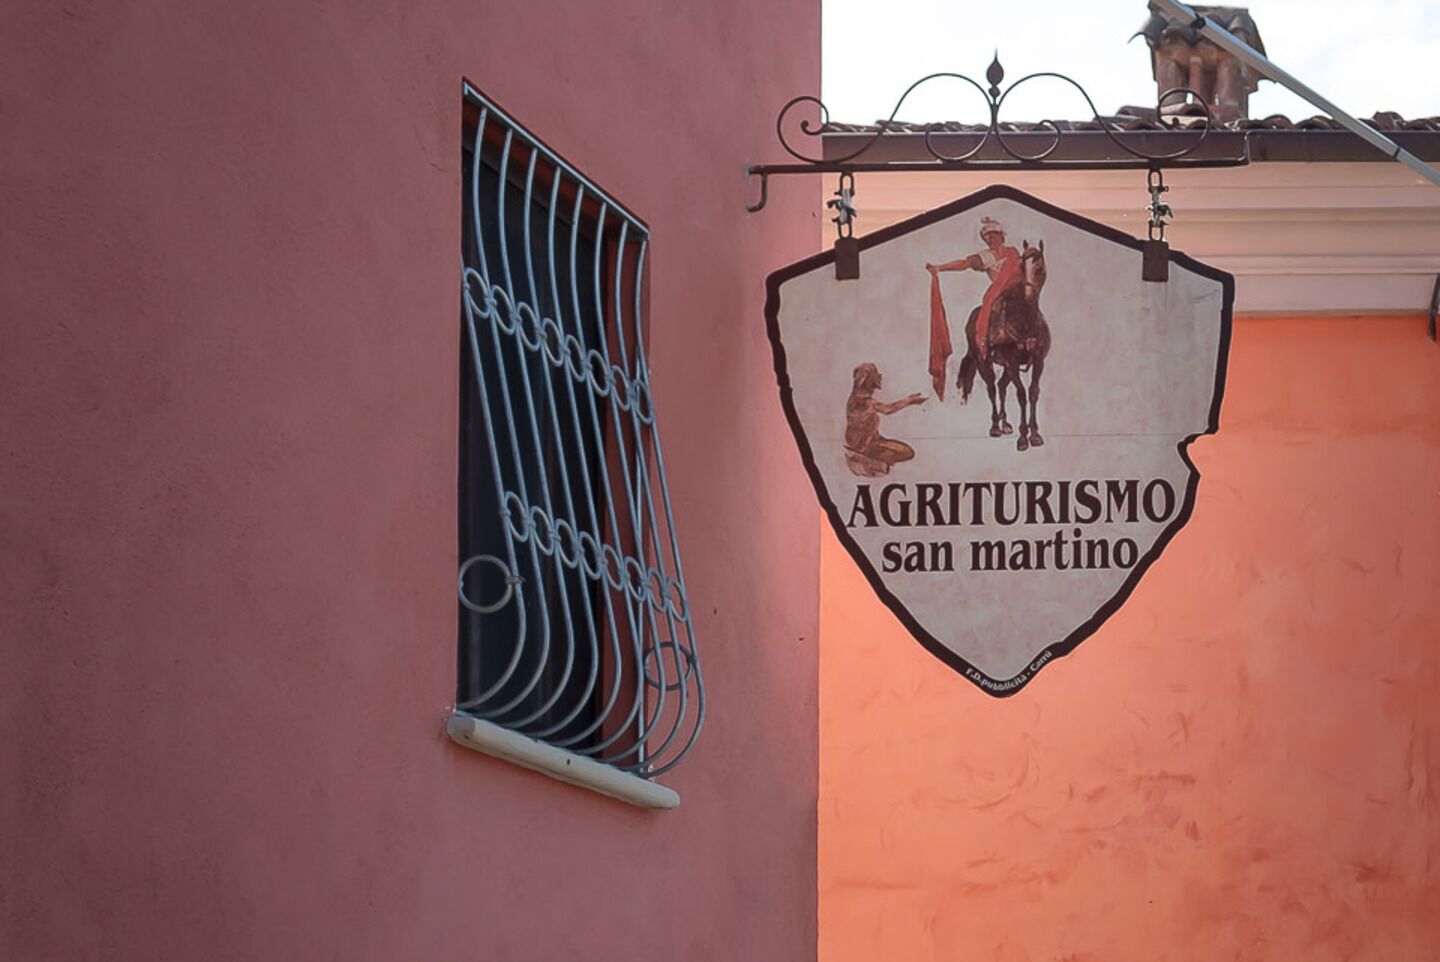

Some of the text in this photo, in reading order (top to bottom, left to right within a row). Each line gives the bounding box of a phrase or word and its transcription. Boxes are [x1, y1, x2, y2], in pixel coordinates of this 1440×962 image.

[846, 478, 1176, 528] AGRITURISMO
[882, 528, 1139, 572] san martino
